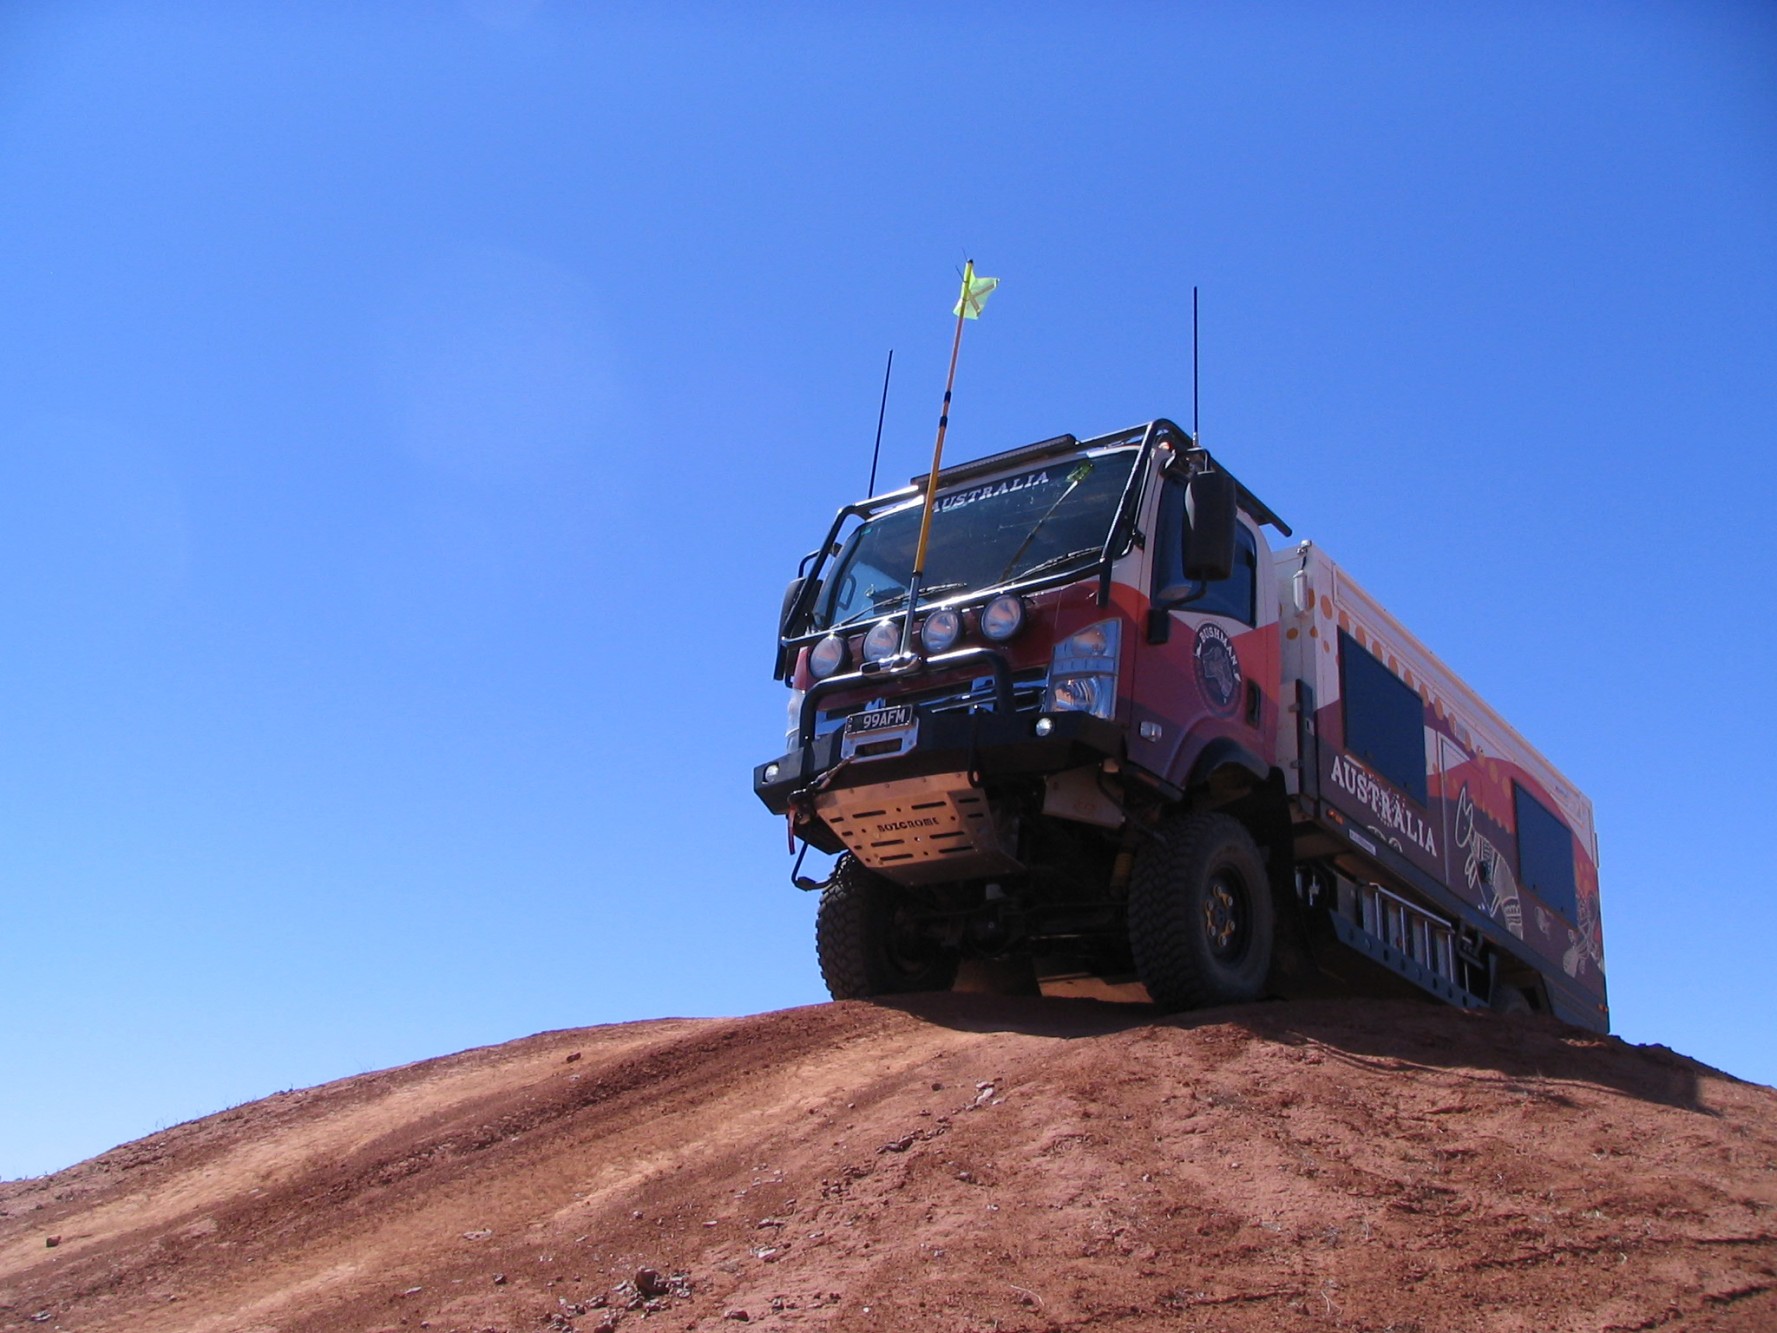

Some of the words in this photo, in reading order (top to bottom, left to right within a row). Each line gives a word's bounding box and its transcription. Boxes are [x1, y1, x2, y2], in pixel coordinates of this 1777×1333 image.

[932, 471, 1049, 513] AUSTRALIA
[1199, 626, 1238, 666] BUSHMAN
[863, 709, 906, 729] 99AFM
[1331, 755, 1437, 858] AUSTRALIA
